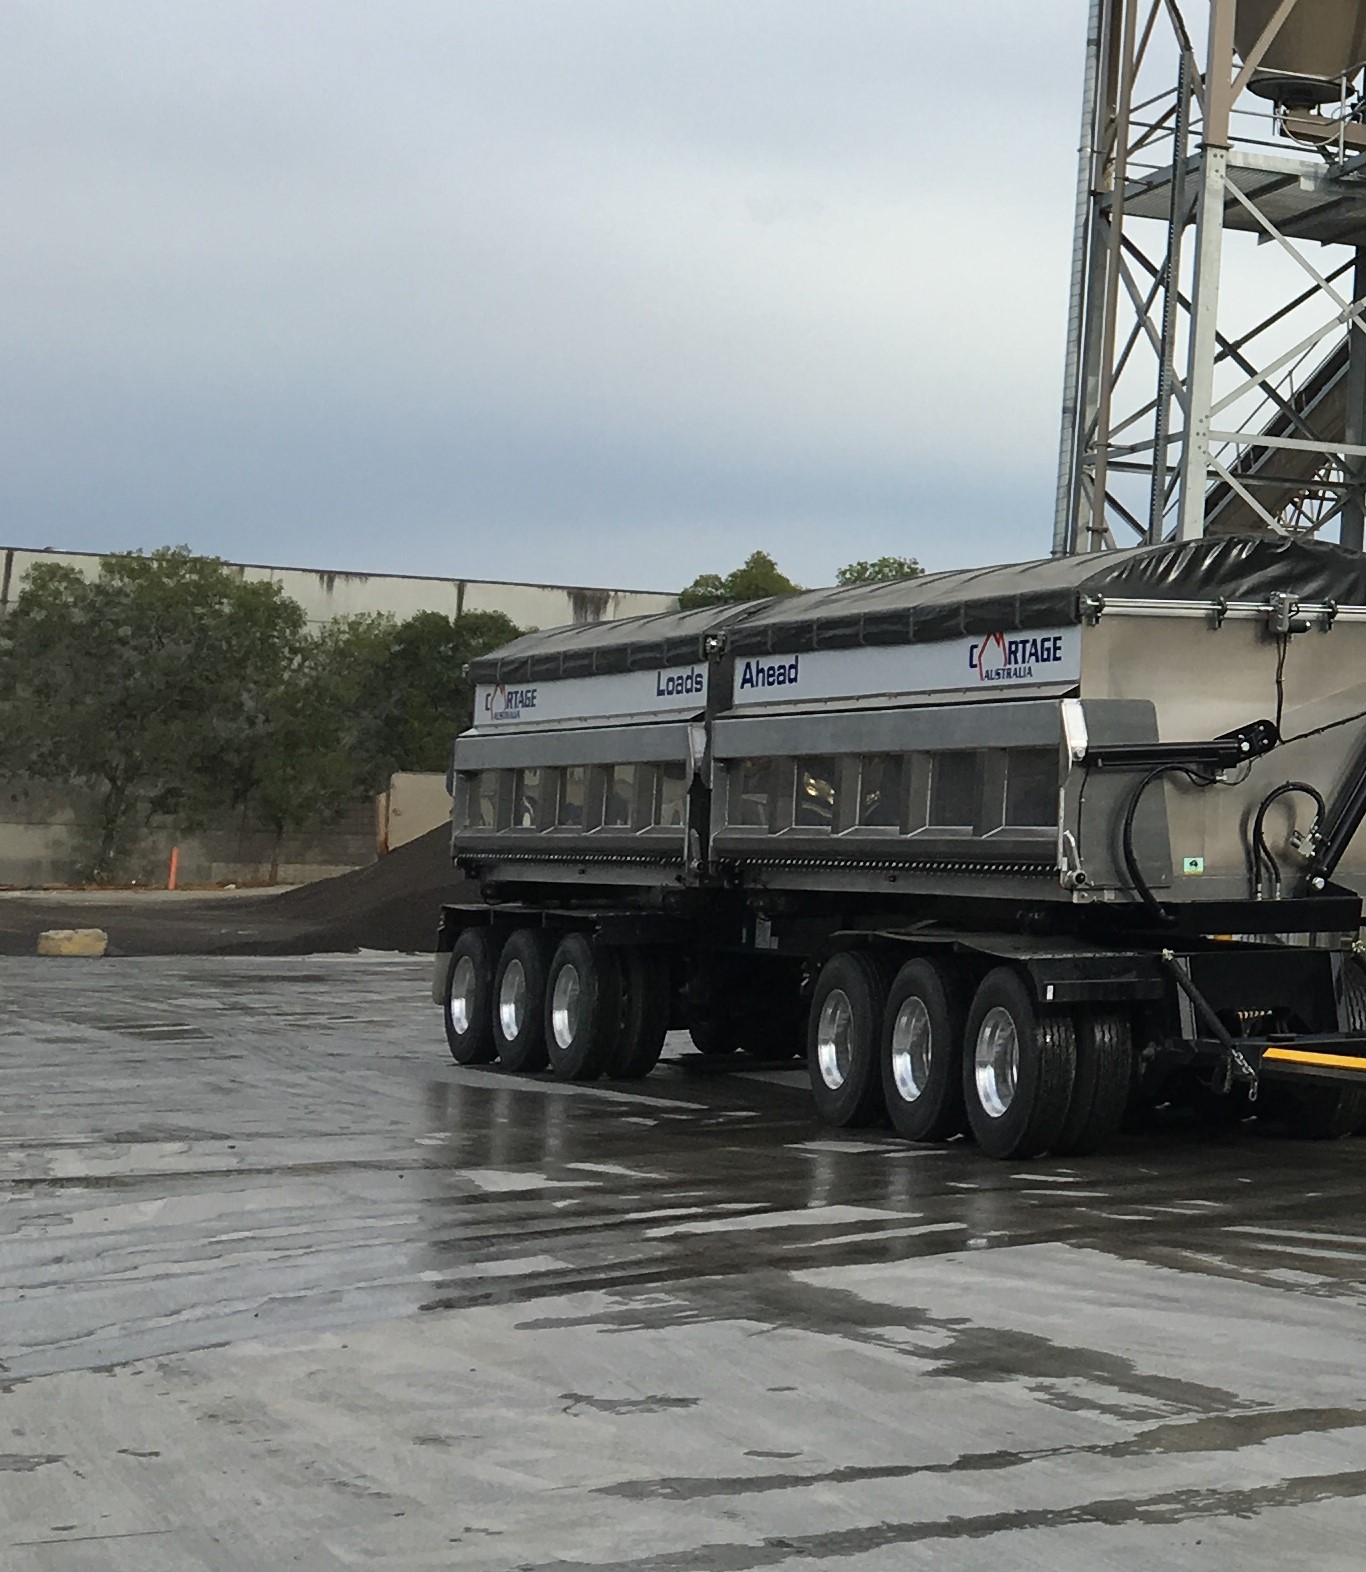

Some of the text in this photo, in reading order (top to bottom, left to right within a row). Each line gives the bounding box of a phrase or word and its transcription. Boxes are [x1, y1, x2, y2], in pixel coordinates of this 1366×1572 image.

[656, 654, 799, 697] Loads Ahead
[984, 666, 1033, 681] AUSTRALIA
